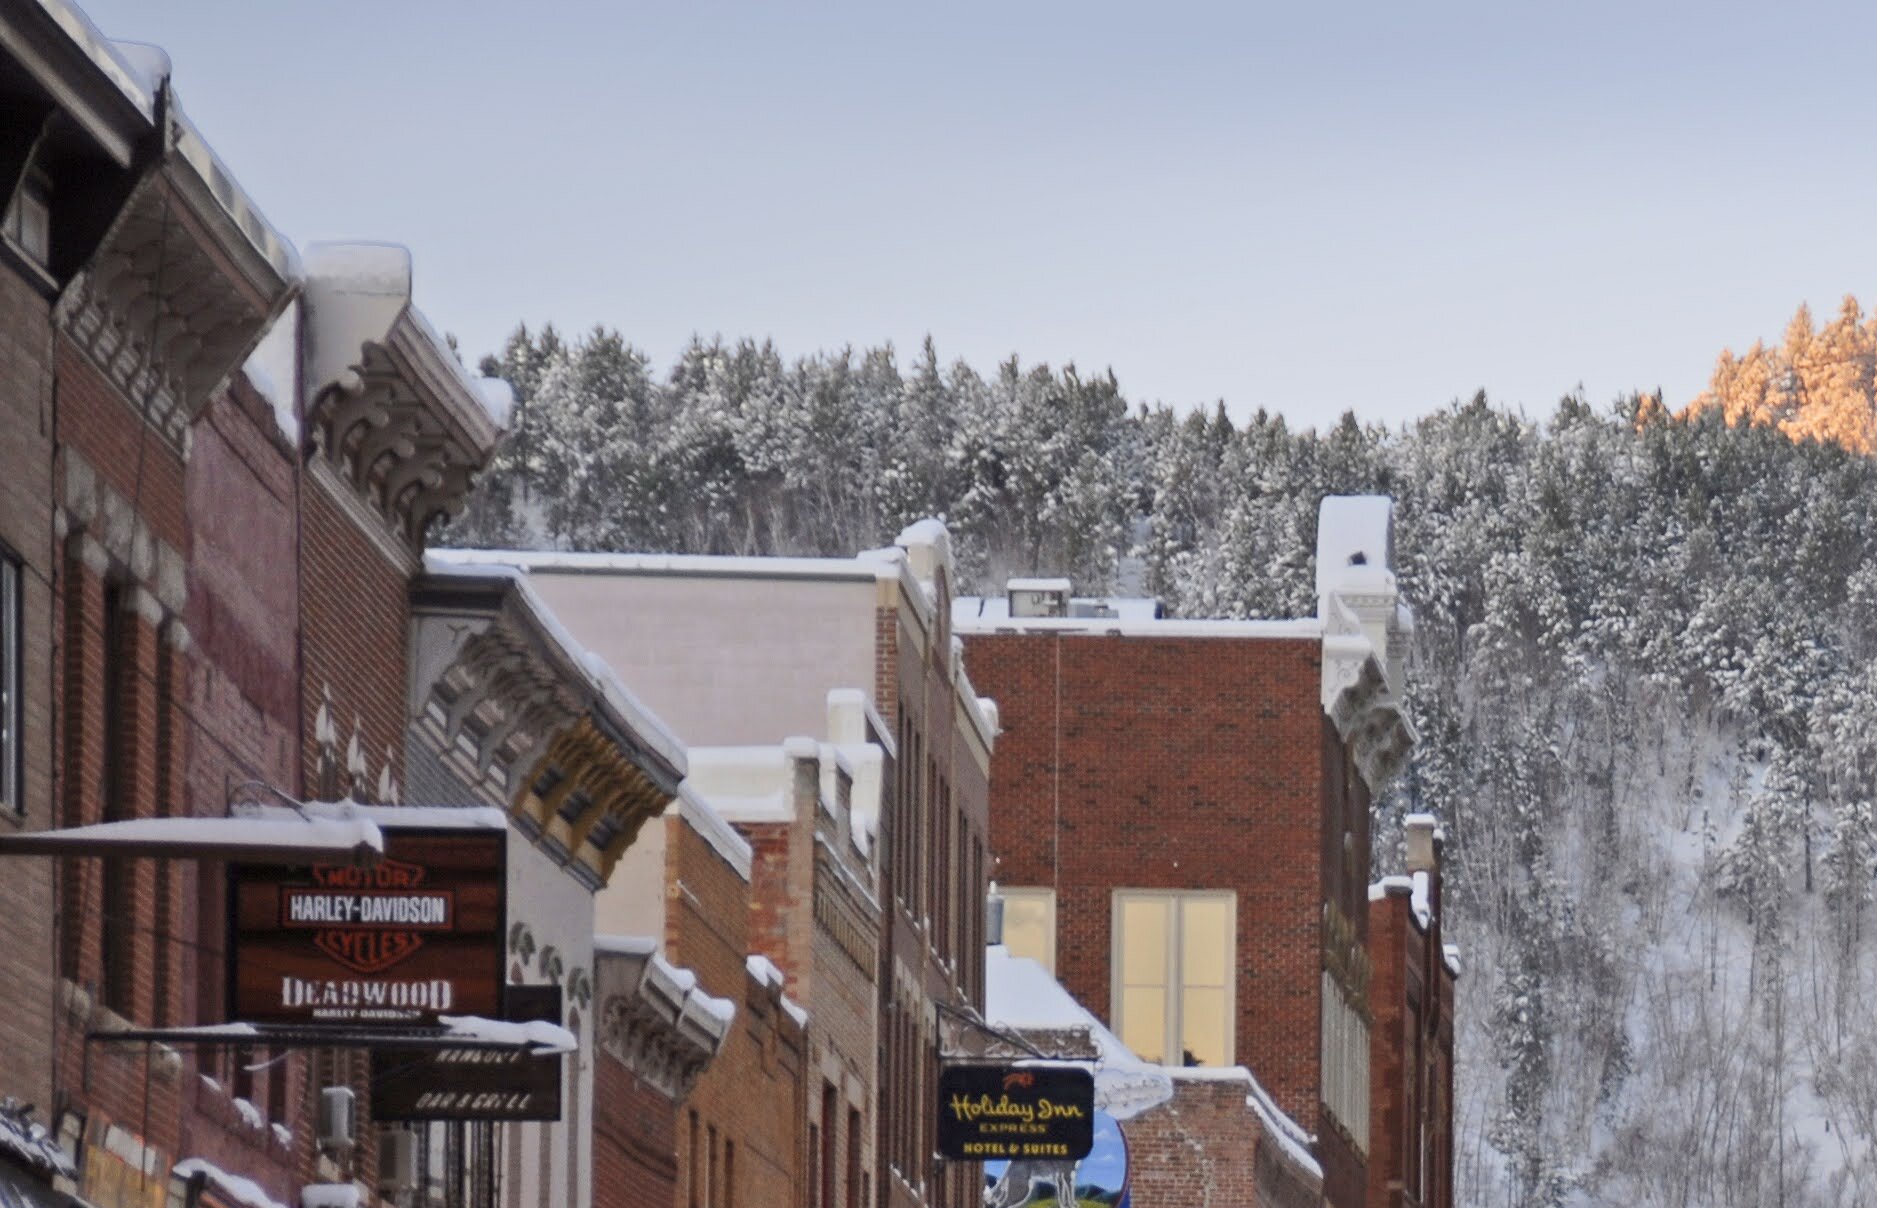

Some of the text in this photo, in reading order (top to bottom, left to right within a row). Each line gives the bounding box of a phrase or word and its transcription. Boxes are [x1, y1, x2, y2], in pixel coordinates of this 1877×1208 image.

[327, 864, 410, 888] MOTOR
[290, 894, 445, 923] HARLEY-DAVIDSON
[327, 931, 410, 963] CYCLES
[281, 976, 451, 1010] DEADWOOD
[951, 1094, 1084, 1122] Holiday Inn
[979, 1122, 1047, 1134] EXPRESS
[963, 1142, 1069, 1156] HOTEL & SUITES
